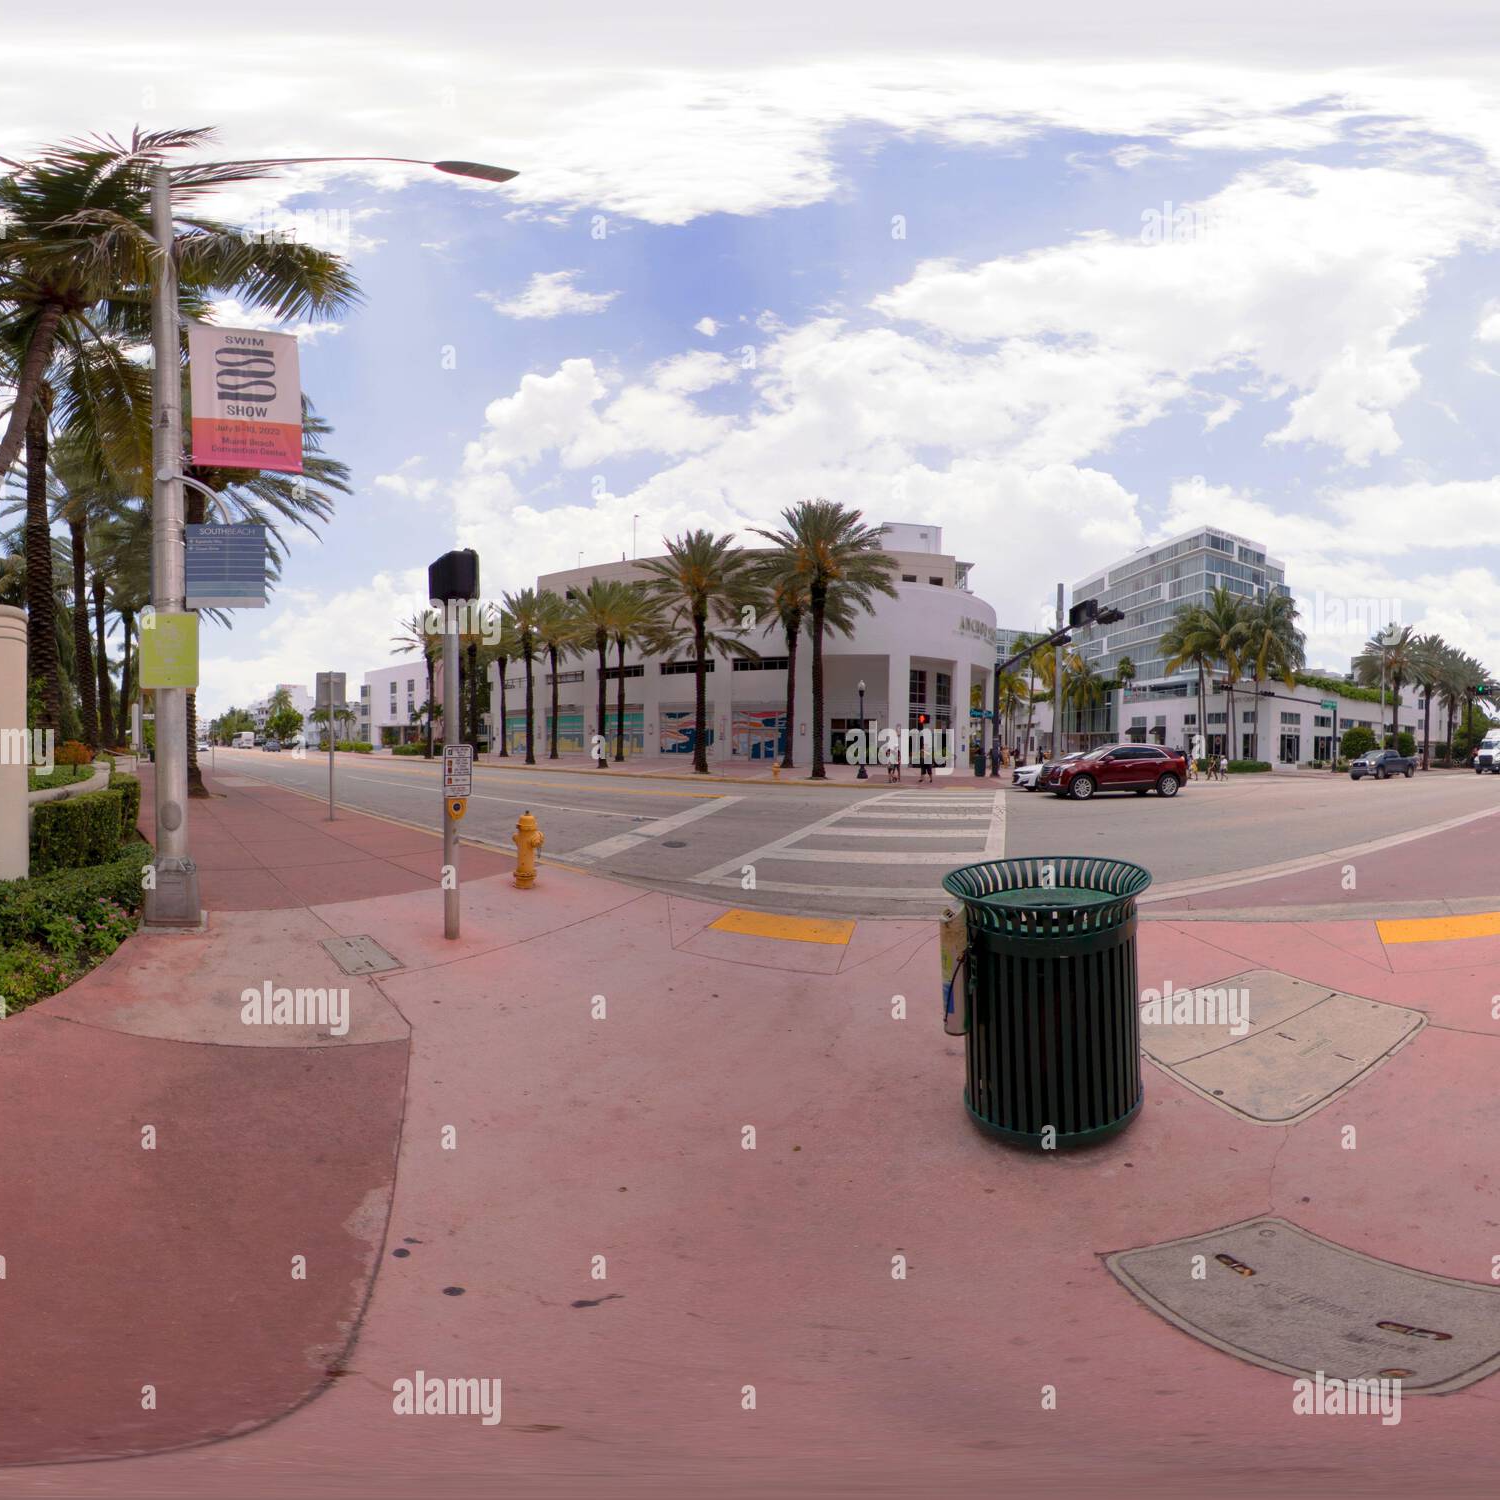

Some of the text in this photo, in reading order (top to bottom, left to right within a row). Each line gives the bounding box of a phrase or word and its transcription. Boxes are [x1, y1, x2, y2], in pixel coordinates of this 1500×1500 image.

[225, 336, 264, 347] SWIM
[227, 405, 268, 418] SHOW
[221, 436, 275, 448] Miami Beach
[212, 444, 286, 457] Convention Center
